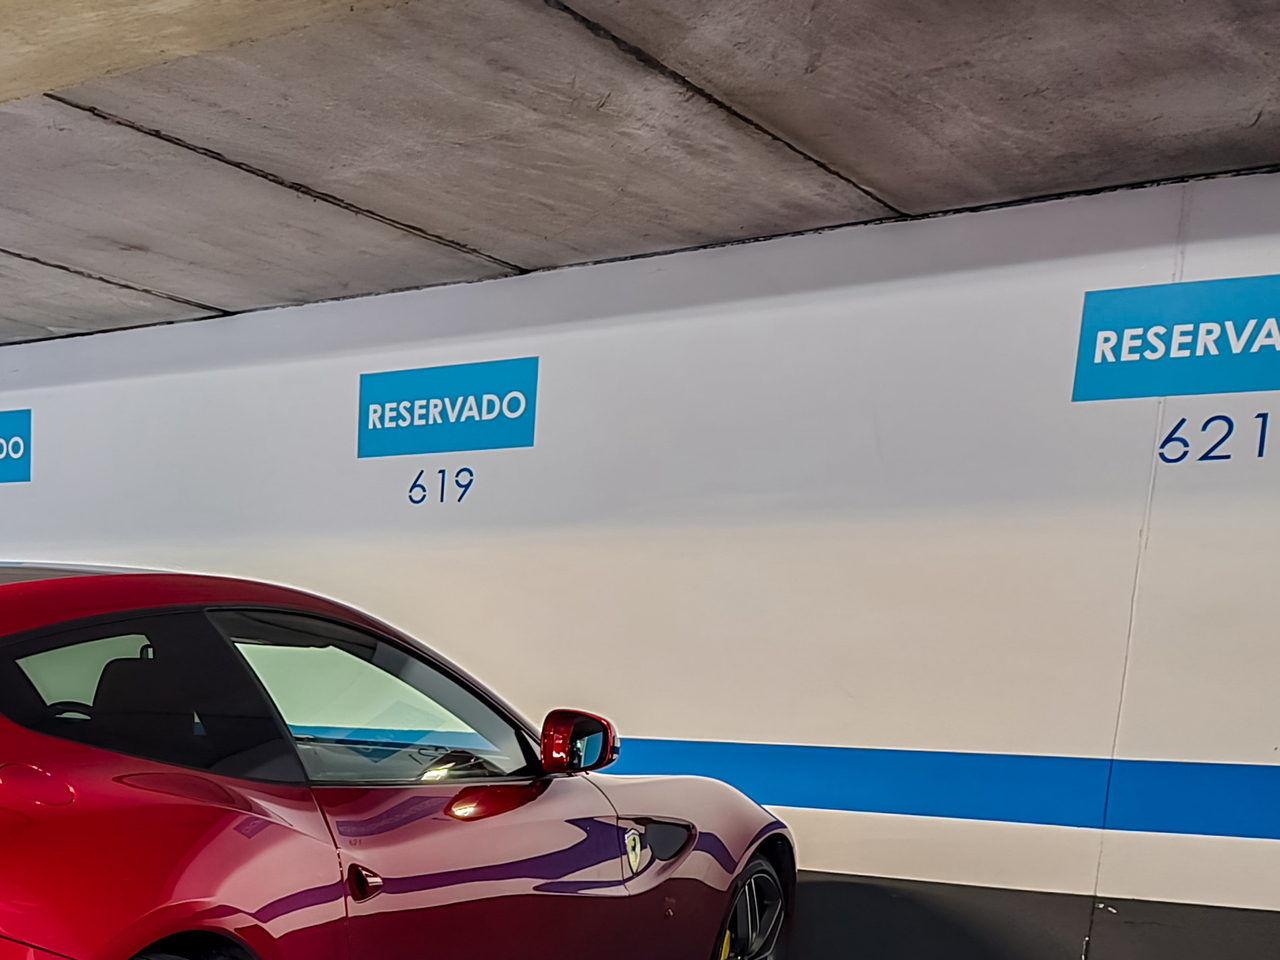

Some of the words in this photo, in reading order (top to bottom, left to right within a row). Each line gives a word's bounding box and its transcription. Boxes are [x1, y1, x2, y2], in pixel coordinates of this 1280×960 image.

[1093, 317, 1280, 364] RESERVA
[367, 391, 527, 429] RESERVADO
[1158, 411, 1270, 464] 621
[408, 467, 474, 504] 619
